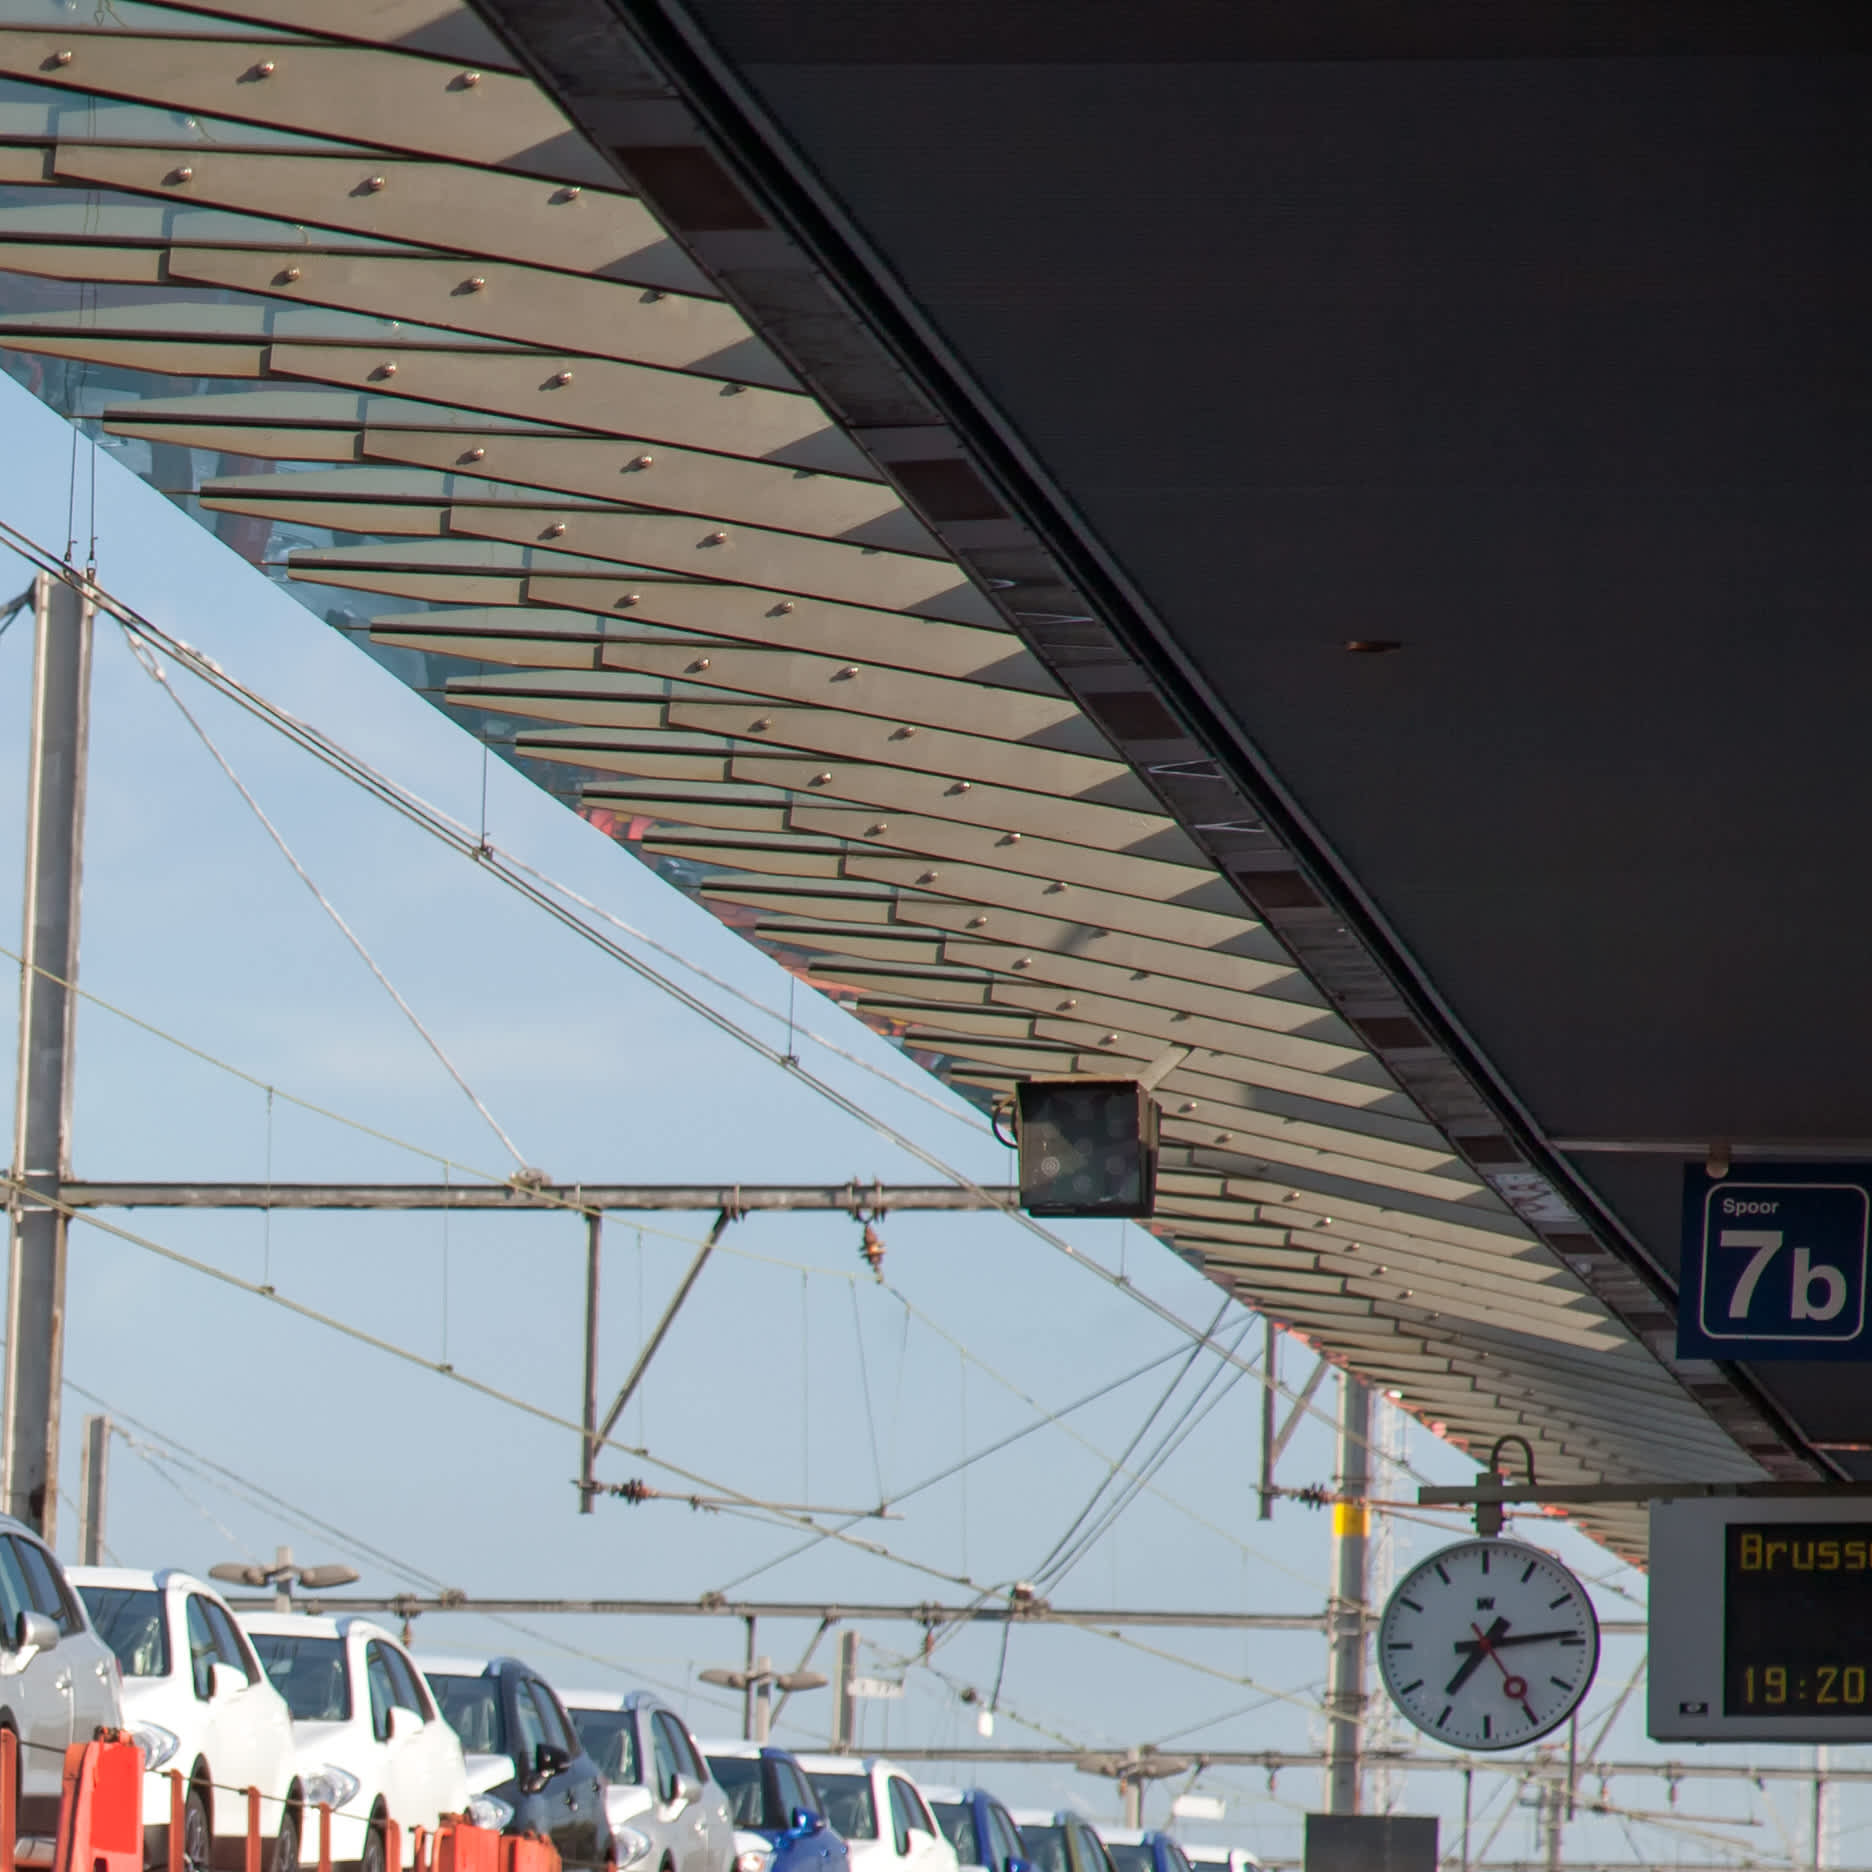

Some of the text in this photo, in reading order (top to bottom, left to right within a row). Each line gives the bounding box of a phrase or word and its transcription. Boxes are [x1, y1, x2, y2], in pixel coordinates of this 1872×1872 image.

[1722, 1198, 1781, 1217] Spoor
[1720, 1230, 1847, 1321] 7b
[1740, 1532, 1872, 1570] Bruss
[1745, 1666, 1865, 1704] 19:20
